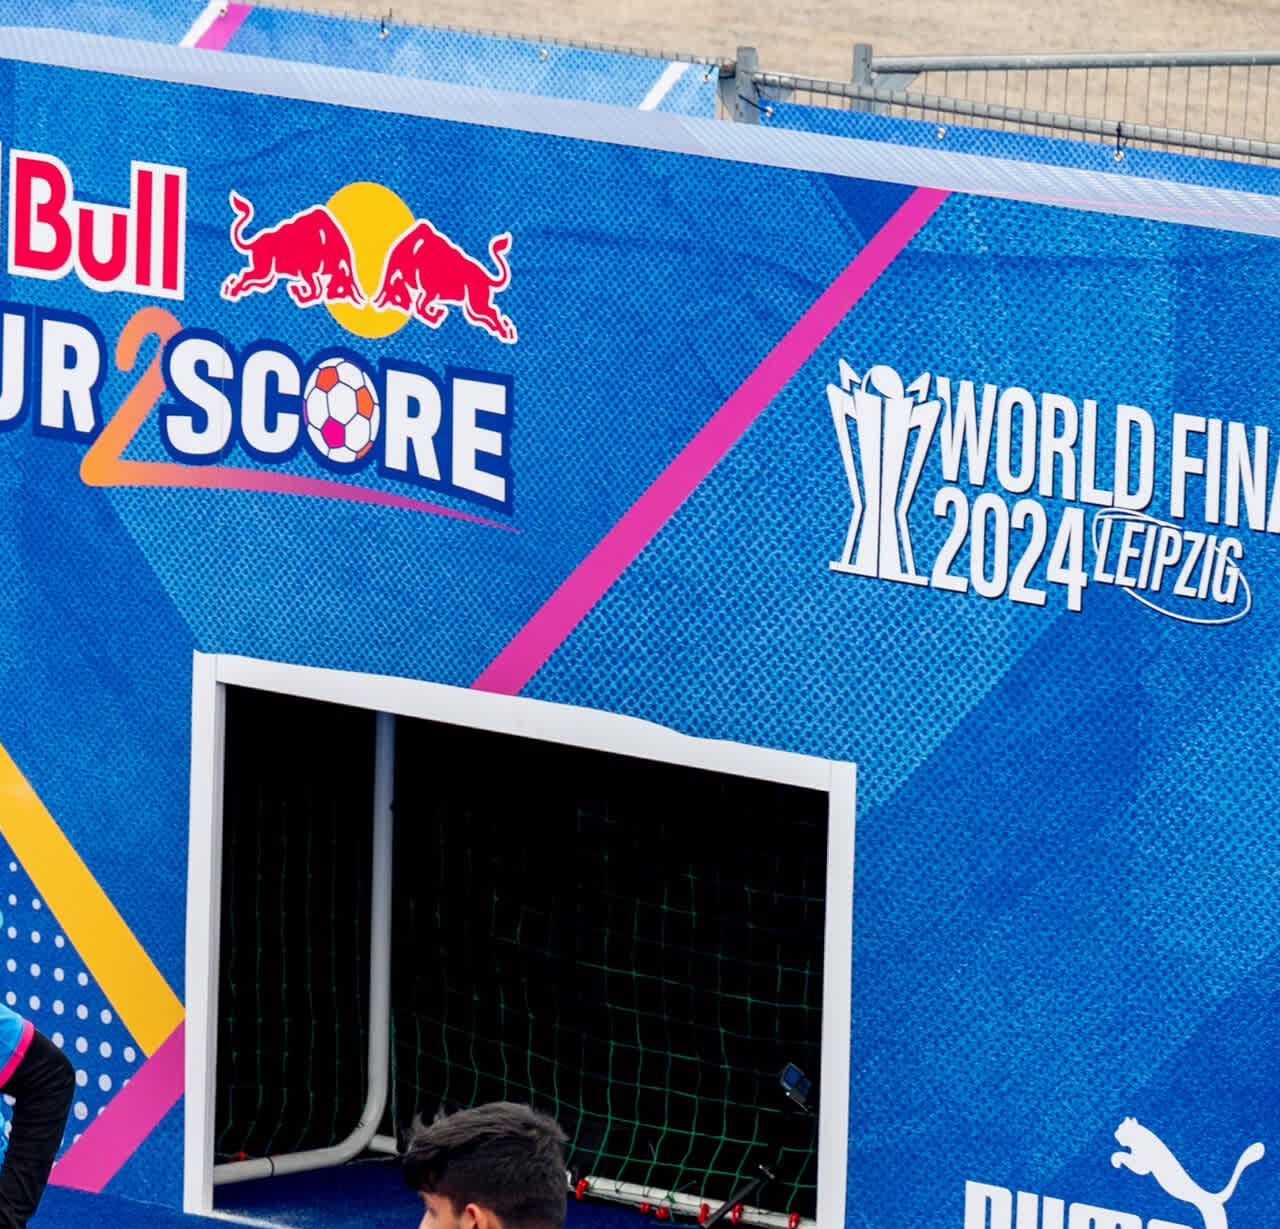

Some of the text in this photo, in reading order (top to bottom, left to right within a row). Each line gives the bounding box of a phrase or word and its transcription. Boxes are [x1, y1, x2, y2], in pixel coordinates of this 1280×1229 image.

[935, 375, 1156, 511] WORLD
[930, 486, 1245, 613] 2024 LEIPZIG
